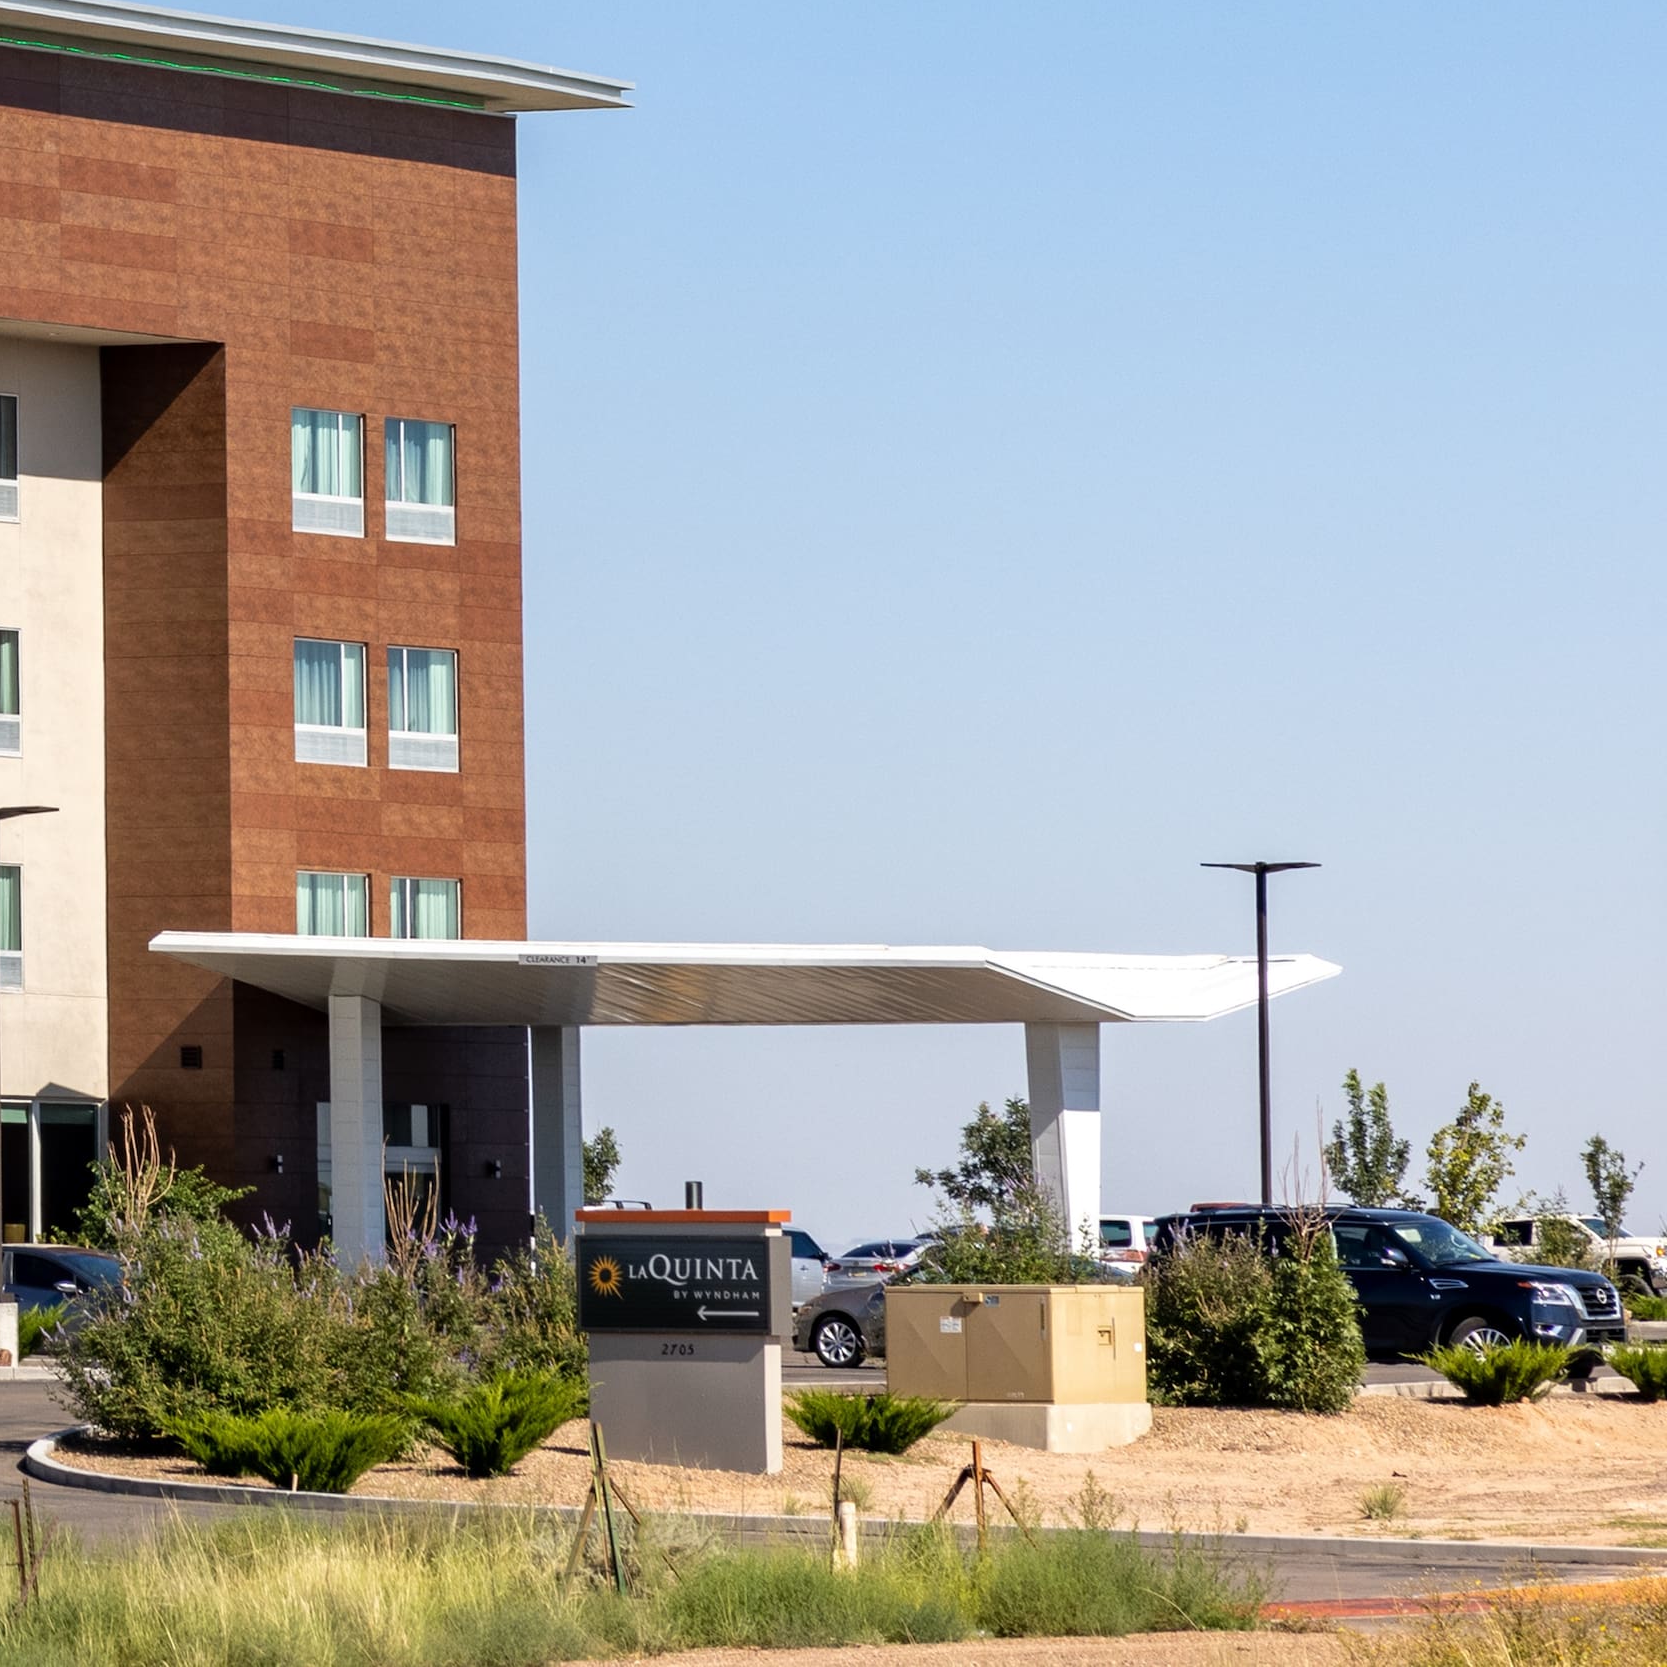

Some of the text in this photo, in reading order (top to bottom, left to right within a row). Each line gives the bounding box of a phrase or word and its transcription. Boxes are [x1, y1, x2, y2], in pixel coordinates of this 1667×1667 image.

[526, 955, 570, 964] CLEARANCE
[628, 1254, 759, 1286] LA QUINTA
[673, 1290, 760, 1300] BY WYNDHAM
[661, 1343, 695, 1356] 2705
